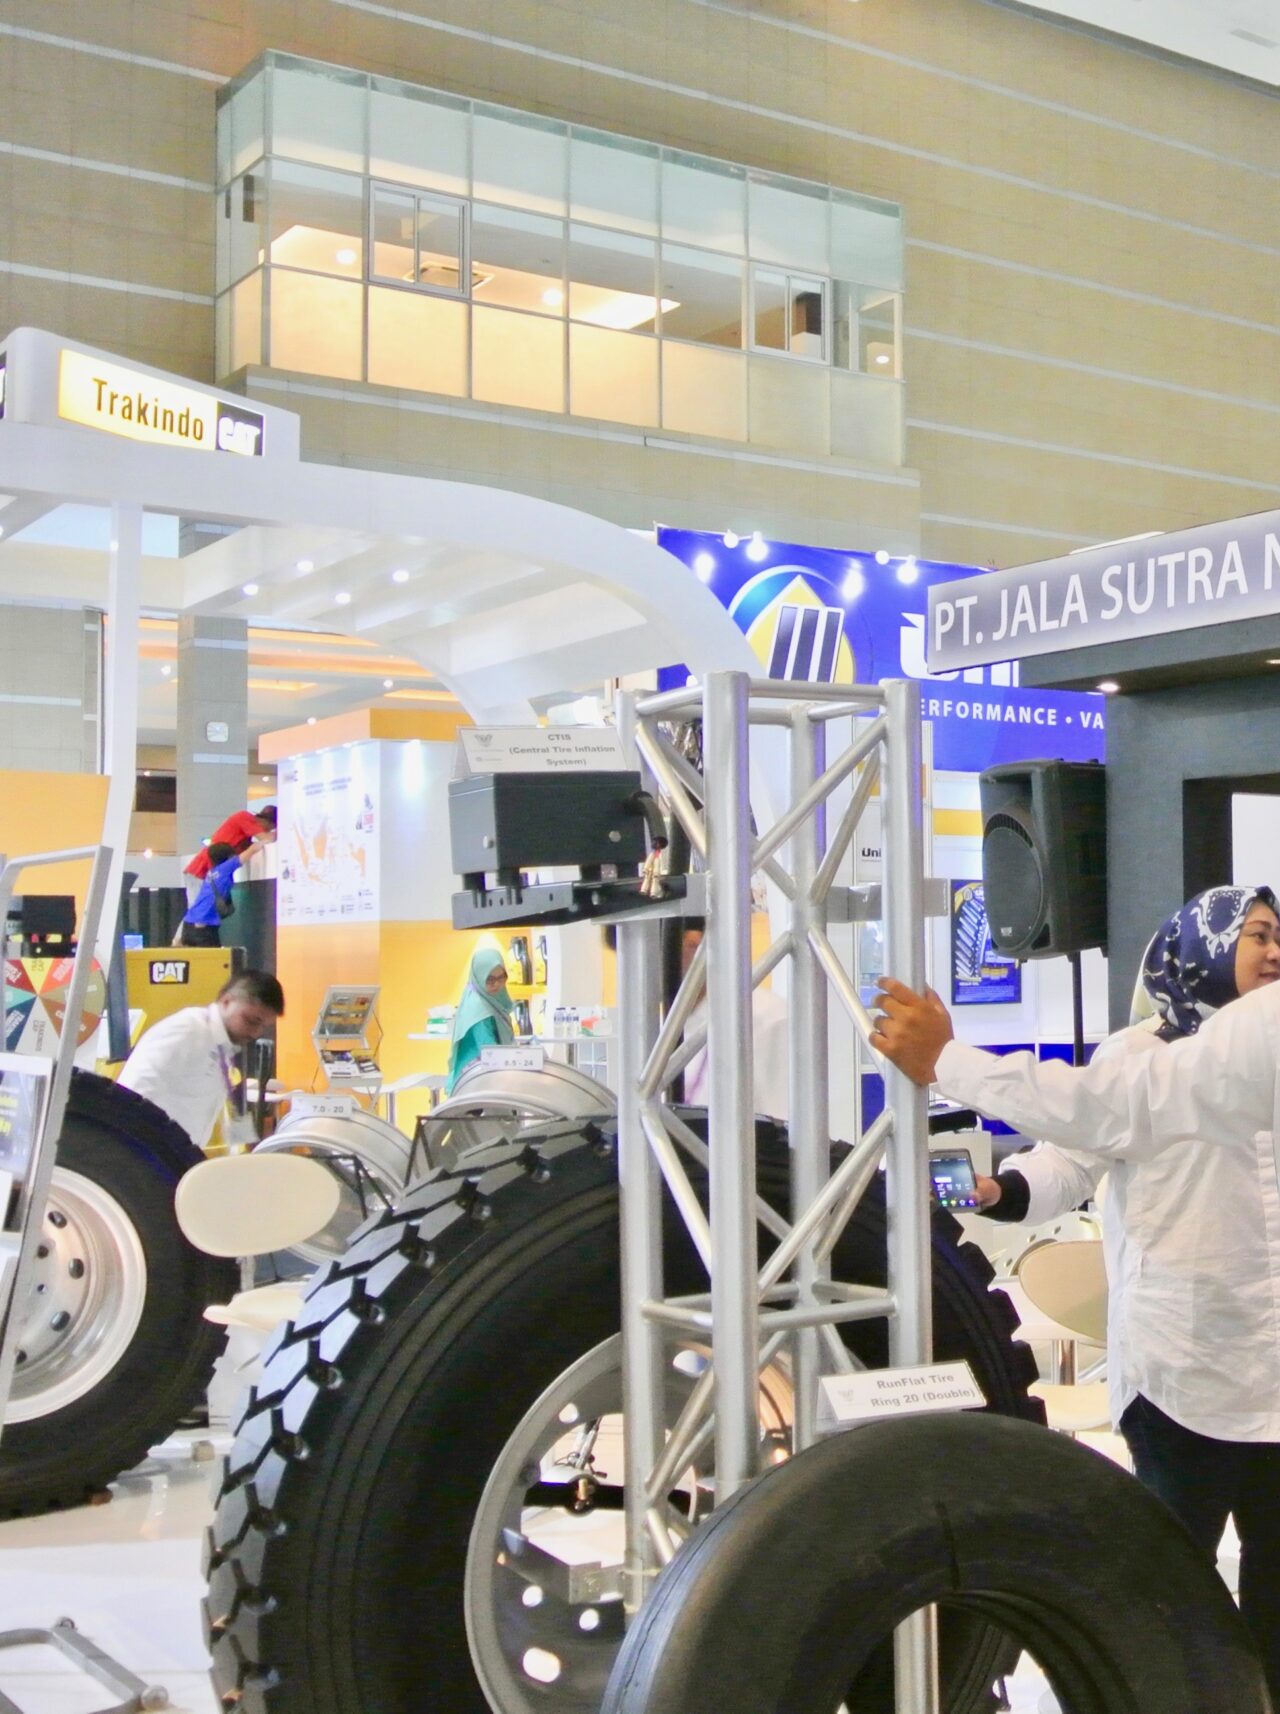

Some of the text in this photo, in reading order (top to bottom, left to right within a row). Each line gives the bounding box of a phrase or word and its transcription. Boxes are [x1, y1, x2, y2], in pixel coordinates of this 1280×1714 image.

[92, 377, 204, 441] Trakindo
[934, 595, 984, 652] PT.
[992, 573, 1088, 641] JALA
[1100, 540, 1248, 620] SUTRA
[921, 698, 1105, 730] RFORMANCE VA
[575, 745, 615, 753] Inflation
[152, 962, 186, 982] CAT
[876, 1373, 955, 1390] RunFlat Tire
[870, 1387, 976, 1408] Ring 20 (Double)
